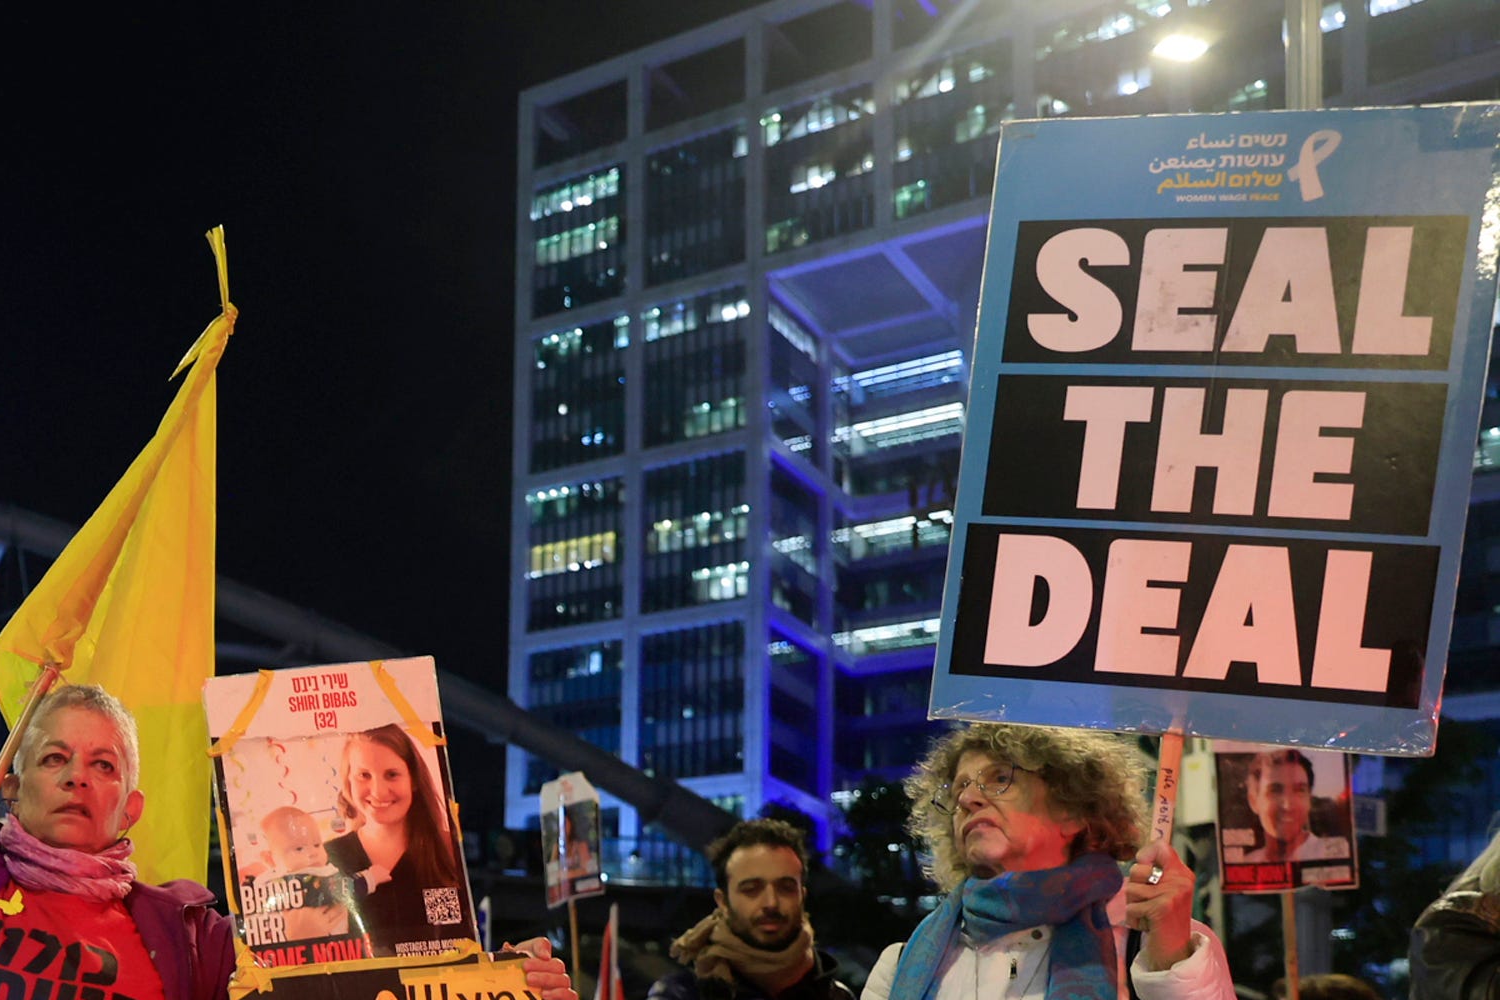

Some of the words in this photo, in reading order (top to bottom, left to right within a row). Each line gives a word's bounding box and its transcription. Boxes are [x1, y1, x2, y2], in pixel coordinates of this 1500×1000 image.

[1186, 131, 1236, 150] نساء
[1238, 132, 1288, 148] נשים
[1219, 153, 1286, 168] עושות
[1156, 171, 1227, 194] السلام
[1228, 169, 1283, 188] שלום
[1176, 194, 1217, 202] WOMEN
[1218, 193, 1248, 202] WAGE
[1249, 192, 1281, 202] PEACE
[1026, 225, 1435, 357] SEAL
[1062, 384, 1368, 522] THE
[982, 532, 1393, 694] DEAL
[291, 676, 320, 693] ביבס
[321, 672, 348, 691] שירי
[288, 694, 321, 713] SHIRI
[322, 690, 357, 709] BIBAS
[313, 711, 338, 729] (32)
[240, 878, 305, 917] BRING
[245, 913, 288, 947] HER
